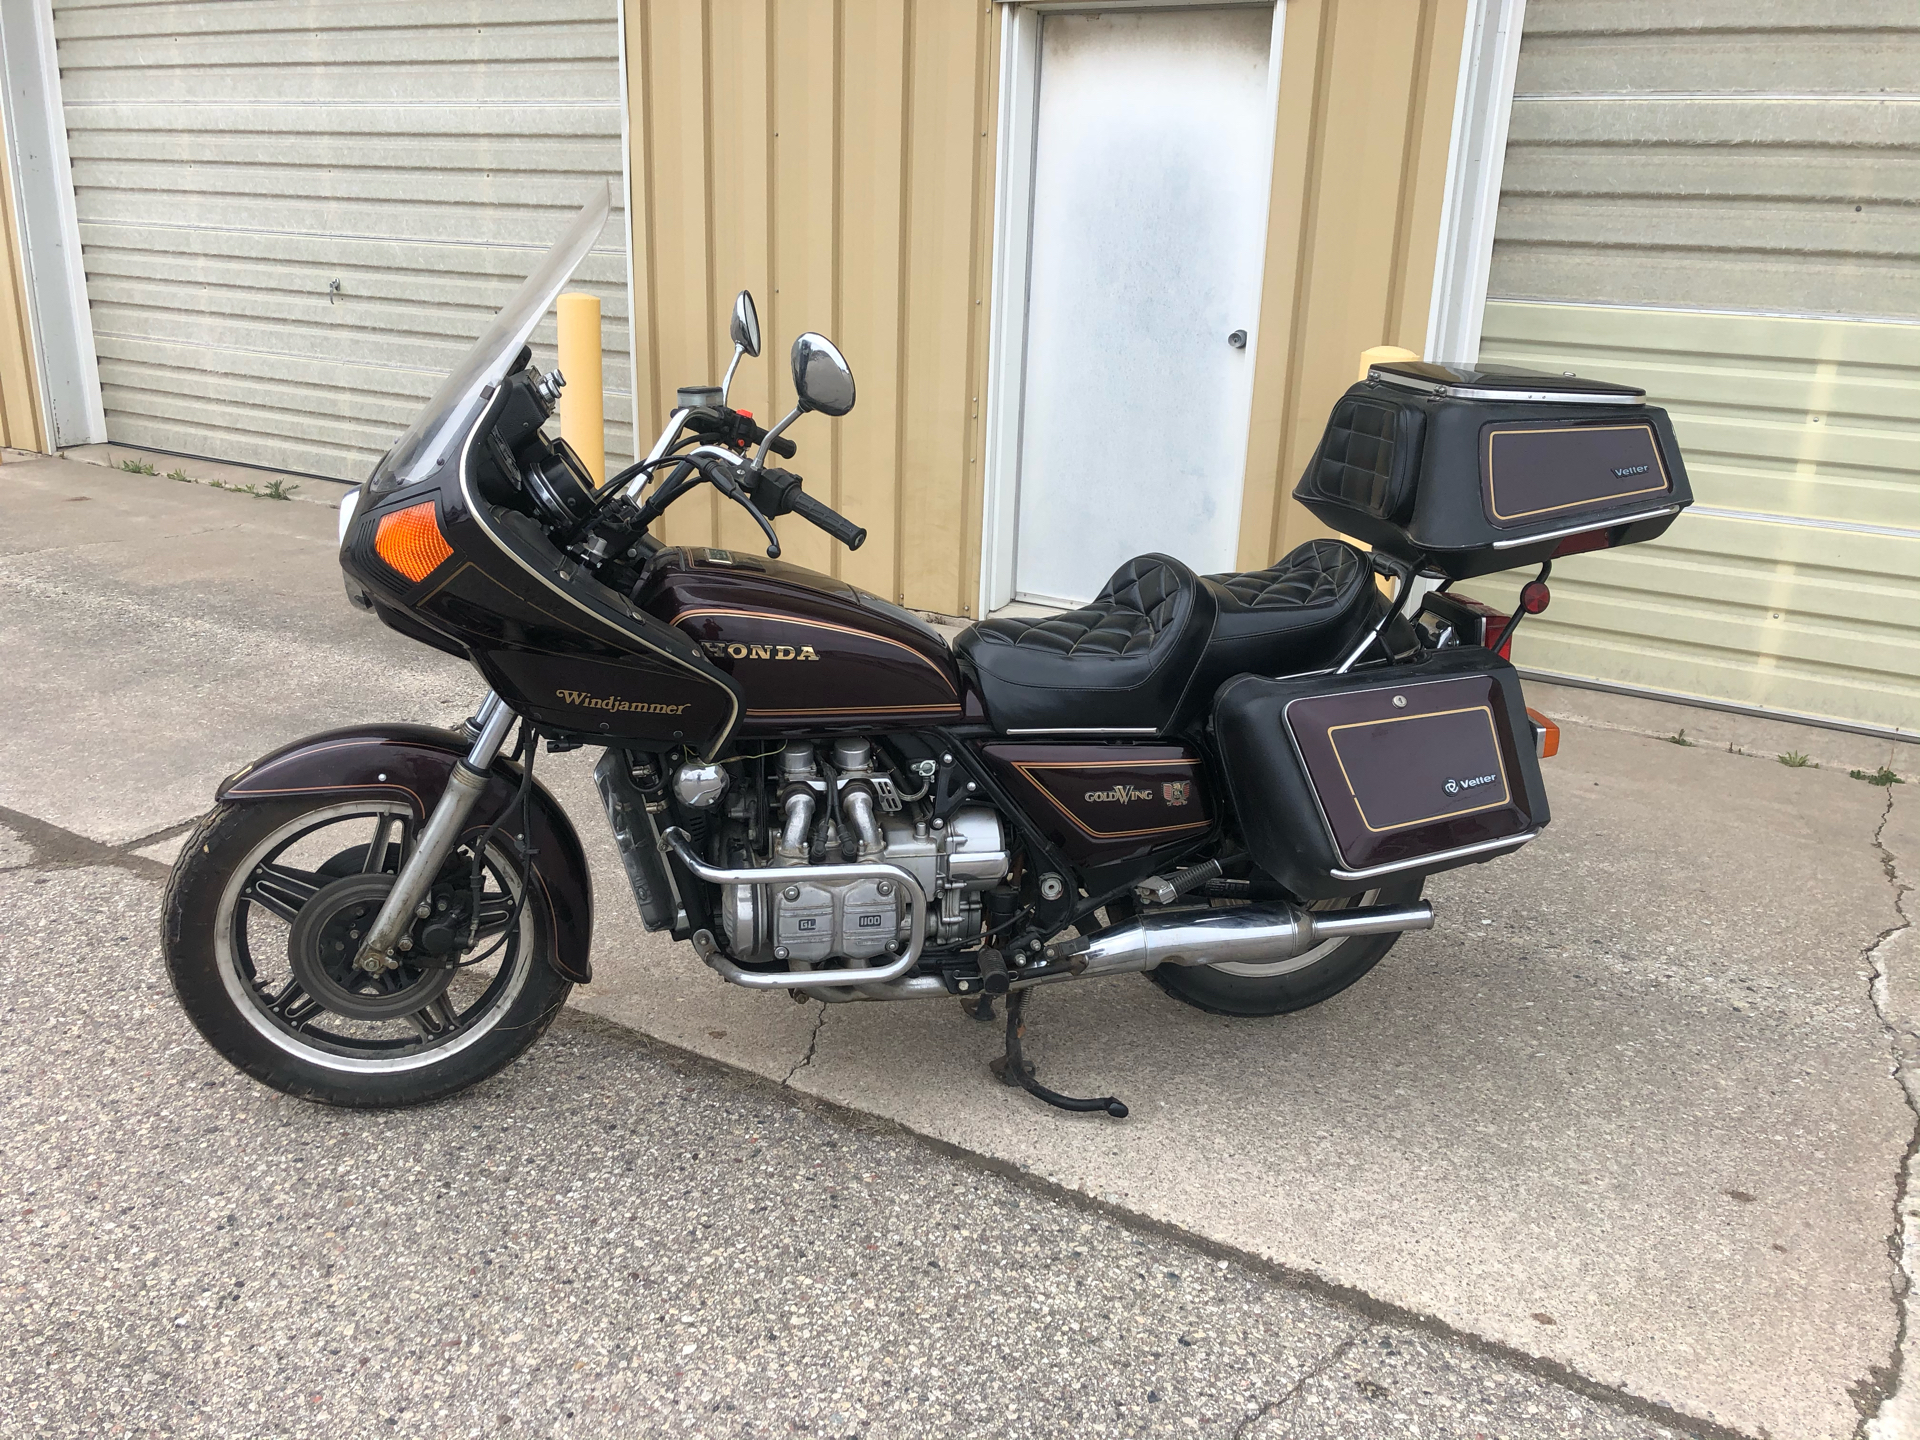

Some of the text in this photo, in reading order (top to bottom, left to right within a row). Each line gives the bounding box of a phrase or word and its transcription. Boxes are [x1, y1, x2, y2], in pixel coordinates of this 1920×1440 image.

[1614, 465, 1649, 477] Vetter
[701, 641, 820, 660] HONDA
[556, 689, 691, 714] Windjammer
[1460, 774, 1496, 788] Vetter
[799, 919, 816, 930] GL
[859, 916, 881, 926] 1100
